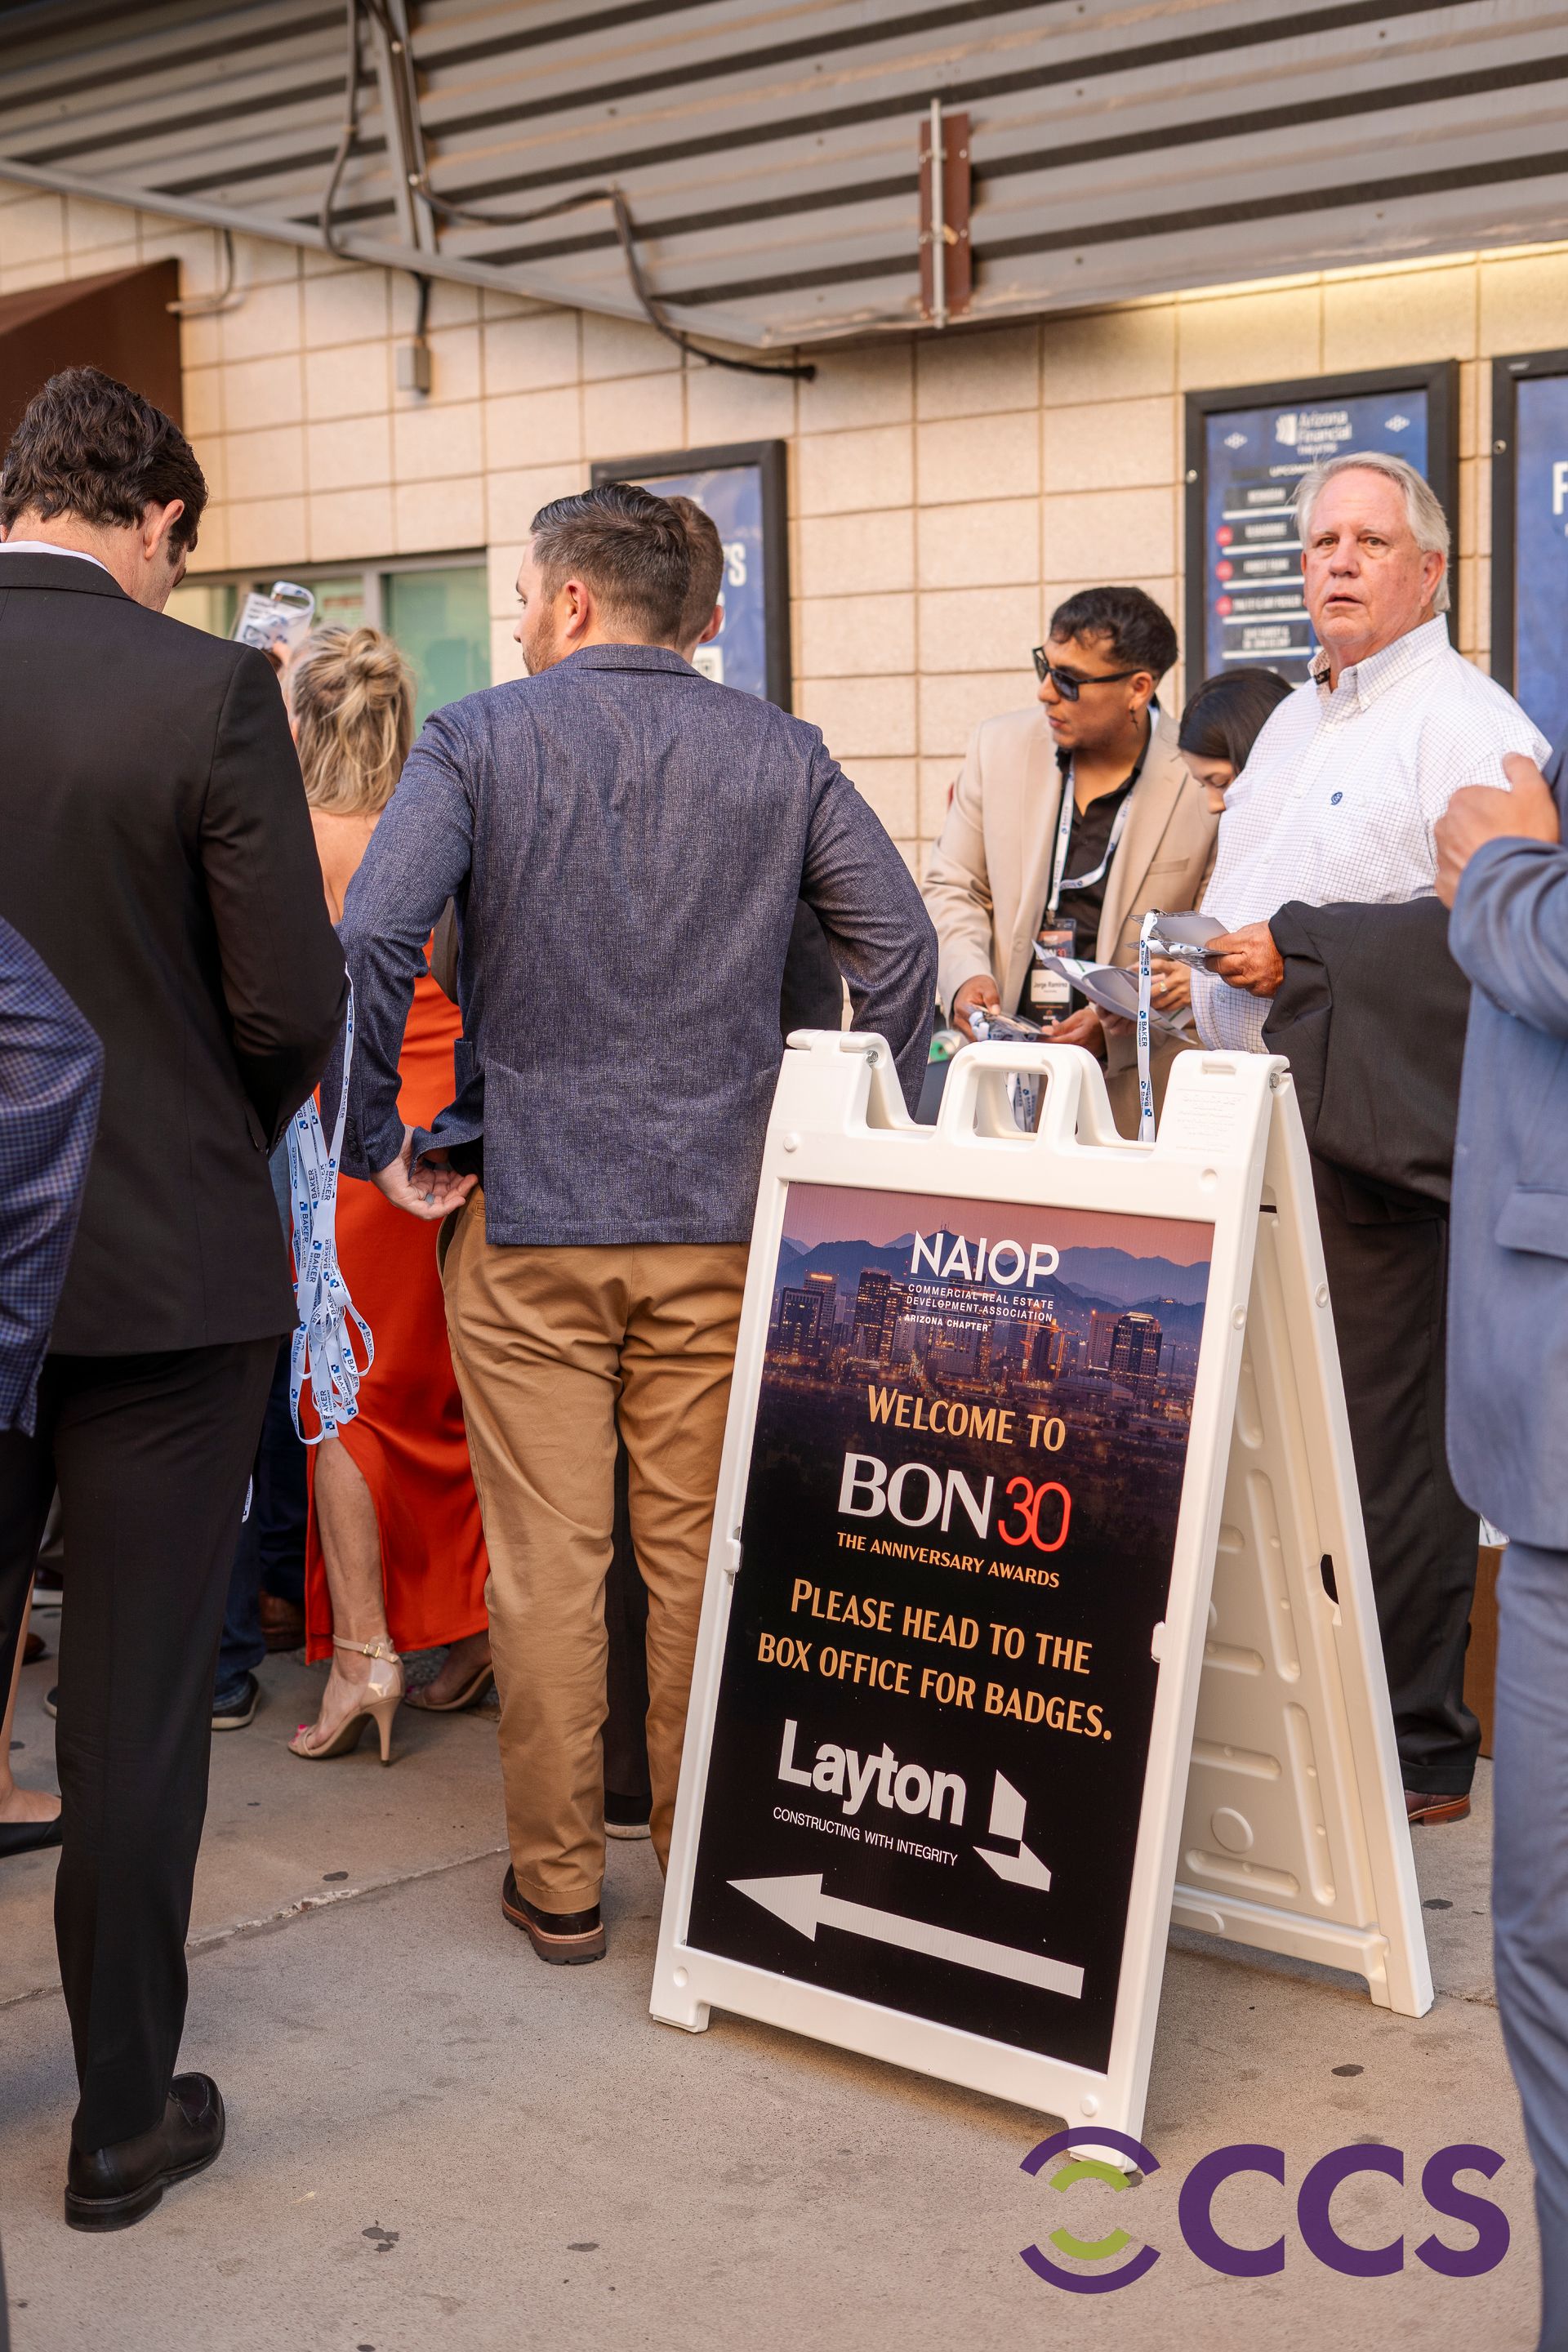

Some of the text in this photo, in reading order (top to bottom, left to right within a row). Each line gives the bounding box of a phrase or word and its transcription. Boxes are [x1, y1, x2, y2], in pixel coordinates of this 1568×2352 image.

[1297, 423, 1353, 443] Financial
[1298, 411, 1348, 428] Arizona
[308, 1169, 318, 1199] BAKER
[324, 1170, 335, 1201] BAKER
[309, 1253, 321, 1283] BAKER
[911, 1230, 1060, 1288] NAIOP
[906, 1295, 1053, 1323] DEVELOPMENT ASSOCIATION
[908, 1284, 1054, 1310] COMMERCIAL REAL ESTATE
[904, 1313, 988, 1332] ARIZONA CHAPTER
[868, 1385, 1066, 1451] WELCOME TO
[837, 1532, 1060, 1588] THE ANNIVERSARY AWARDS
[791, 1579, 1093, 1675] PLEASE HEAD TO THE
[757, 1633, 1112, 1741] BOX OFFICE FOR BADGES.
[778, 1719, 967, 1826] Layton
[773, 1806, 958, 1866] CONSTRUCTING WITH INTEGRITY
